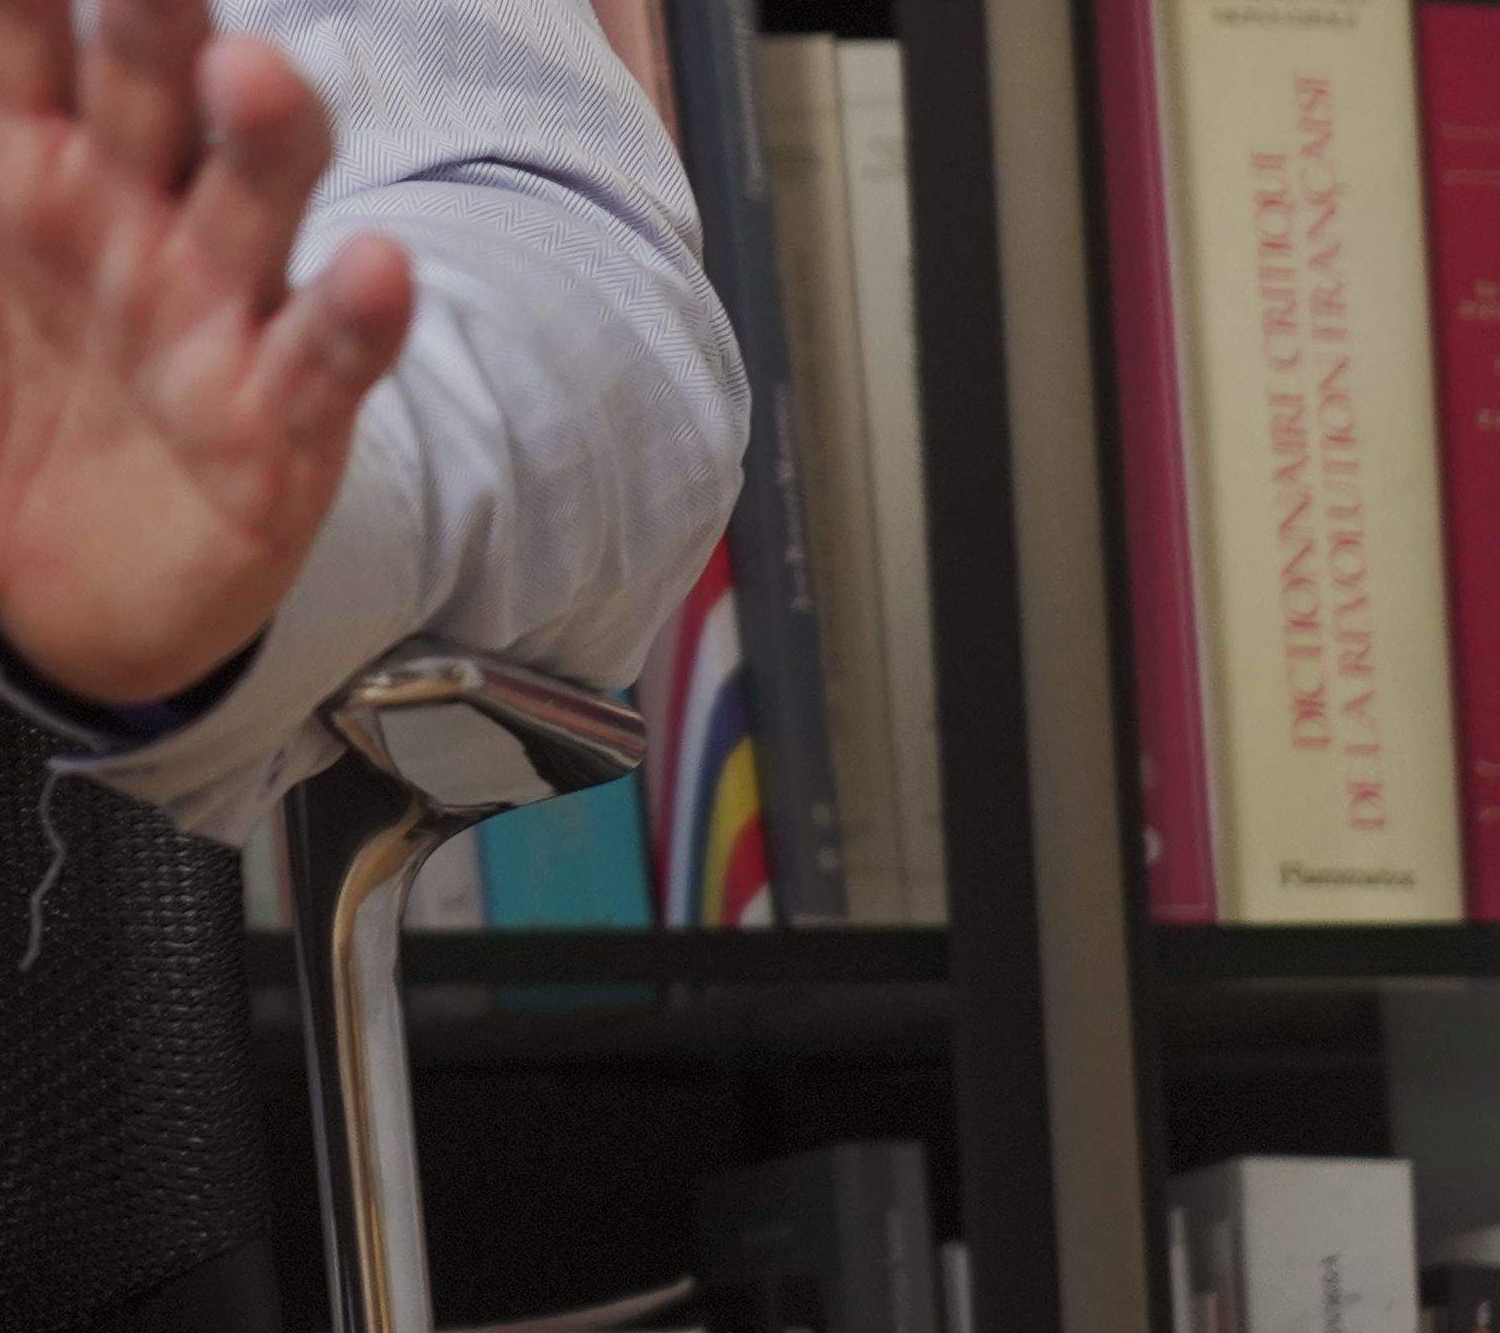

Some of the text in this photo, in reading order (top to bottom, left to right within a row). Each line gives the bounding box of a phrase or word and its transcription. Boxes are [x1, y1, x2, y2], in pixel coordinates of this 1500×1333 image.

[1293, 73, 1351, 345] FRANÇAISE
[1249, 147, 1333, 753] DICTIONNAIRE CRITIQUE
